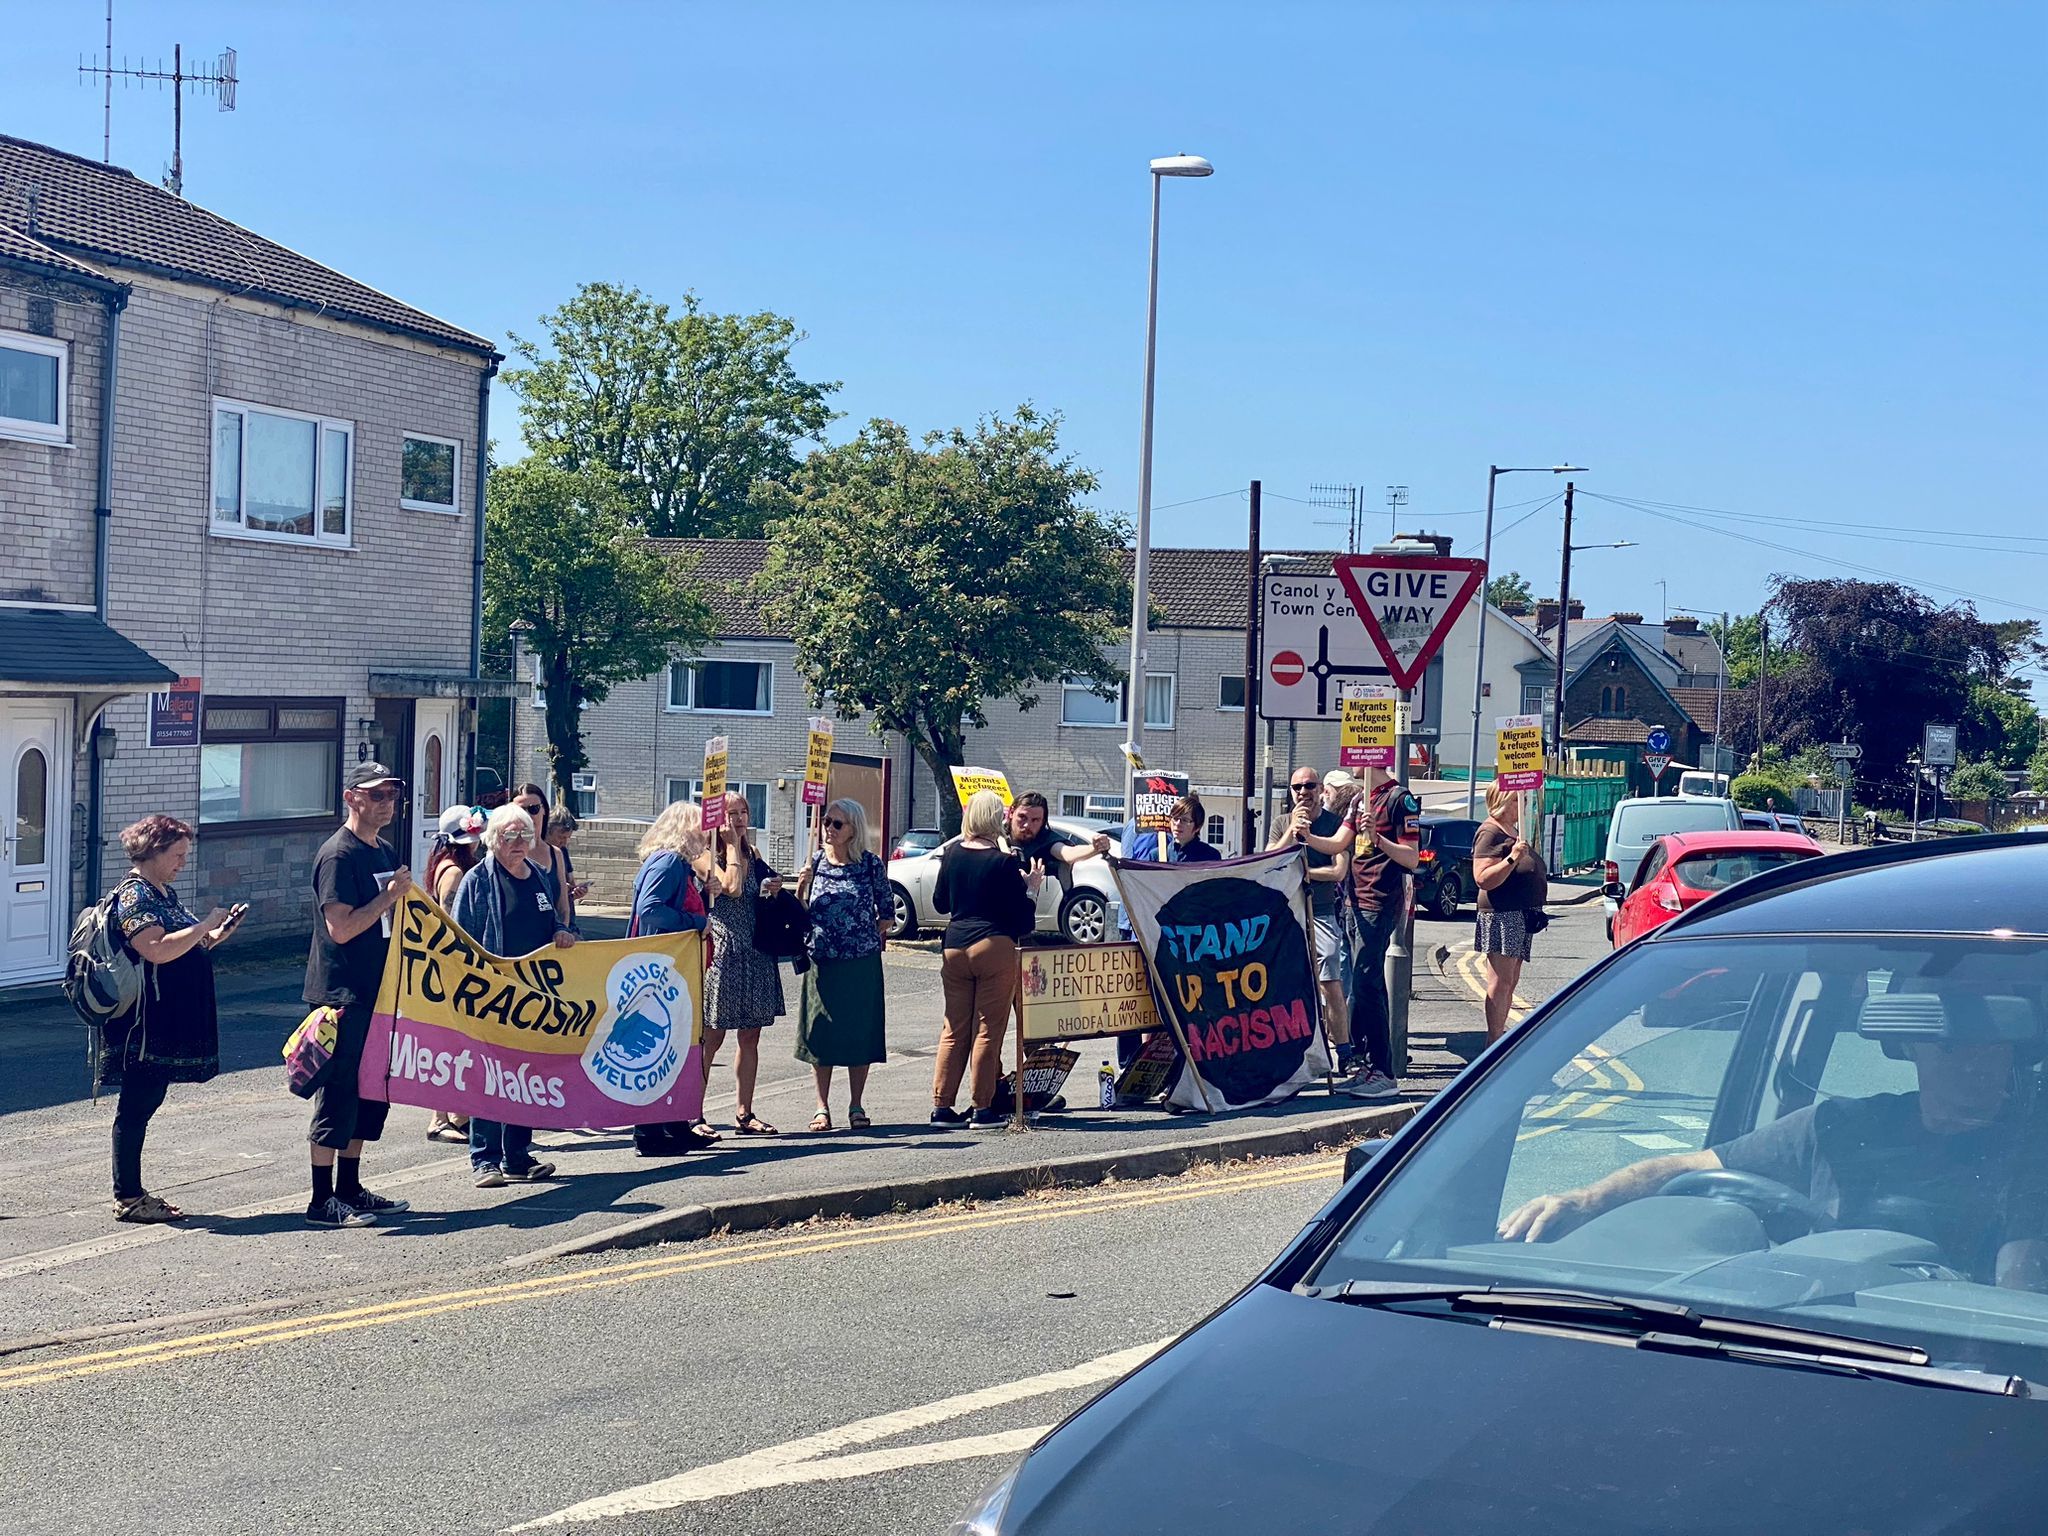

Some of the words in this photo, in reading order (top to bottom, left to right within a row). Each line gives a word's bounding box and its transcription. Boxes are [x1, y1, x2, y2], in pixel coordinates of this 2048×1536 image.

[1270, 582, 1318, 598] Canol
[1326, 586, 1336, 600] y
[1366, 571, 1448, 598] GIVE
[1270, 601, 1314, 616] Town
[1323, 602, 1361, 617] Cen
[1383, 606, 1435, 624] WAY
[170, 678, 189, 689] OLD
[157, 692, 194, 712] Mallard
[1350, 702, 1387, 713] Migrants
[1345, 713, 1351, 722] &
[1354, 713, 1392, 724] refugees
[1349, 724, 1386, 732] welcome
[1503, 730, 1536, 741] Migrants
[1358, 735, 1377, 743] here
[1500, 742, 1506, 750] &
[1508, 741, 1539, 750] refugees
[1504, 751, 1536, 760] welcome
[1513, 761, 1528, 769] here
[960, 776, 1000, 784] Migrants
[968, 783, 1007, 792] refugees
[1136, 794, 1184, 805] REFUGE
[1136, 804, 1172, 816] WELCO
[404, 900, 501, 974] STA
[513, 960, 564, 996] UP
[1053, 952, 1096, 974] HEOL
[1102, 950, 1140, 971] PENT
[402, 948, 446, 1002] TO
[453, 973, 596, 1038] RACISM
[1053, 972, 1148, 998] PENTREPOET
[1216, 962, 1268, 1010] TO
[1102, 1002, 1108, 1013] A
[1118, 1000, 1137, 1012] AND
[1058, 1016, 1103, 1032] RHODFA
[1107, 1010, 1158, 1028] LLWYNEIT
[390, 1031, 474, 1092] West
[591, 1046, 678, 1092] WELCOME
[480, 1054, 566, 1108] Wales
[1103, 1076, 1114, 1108] YAZOO
